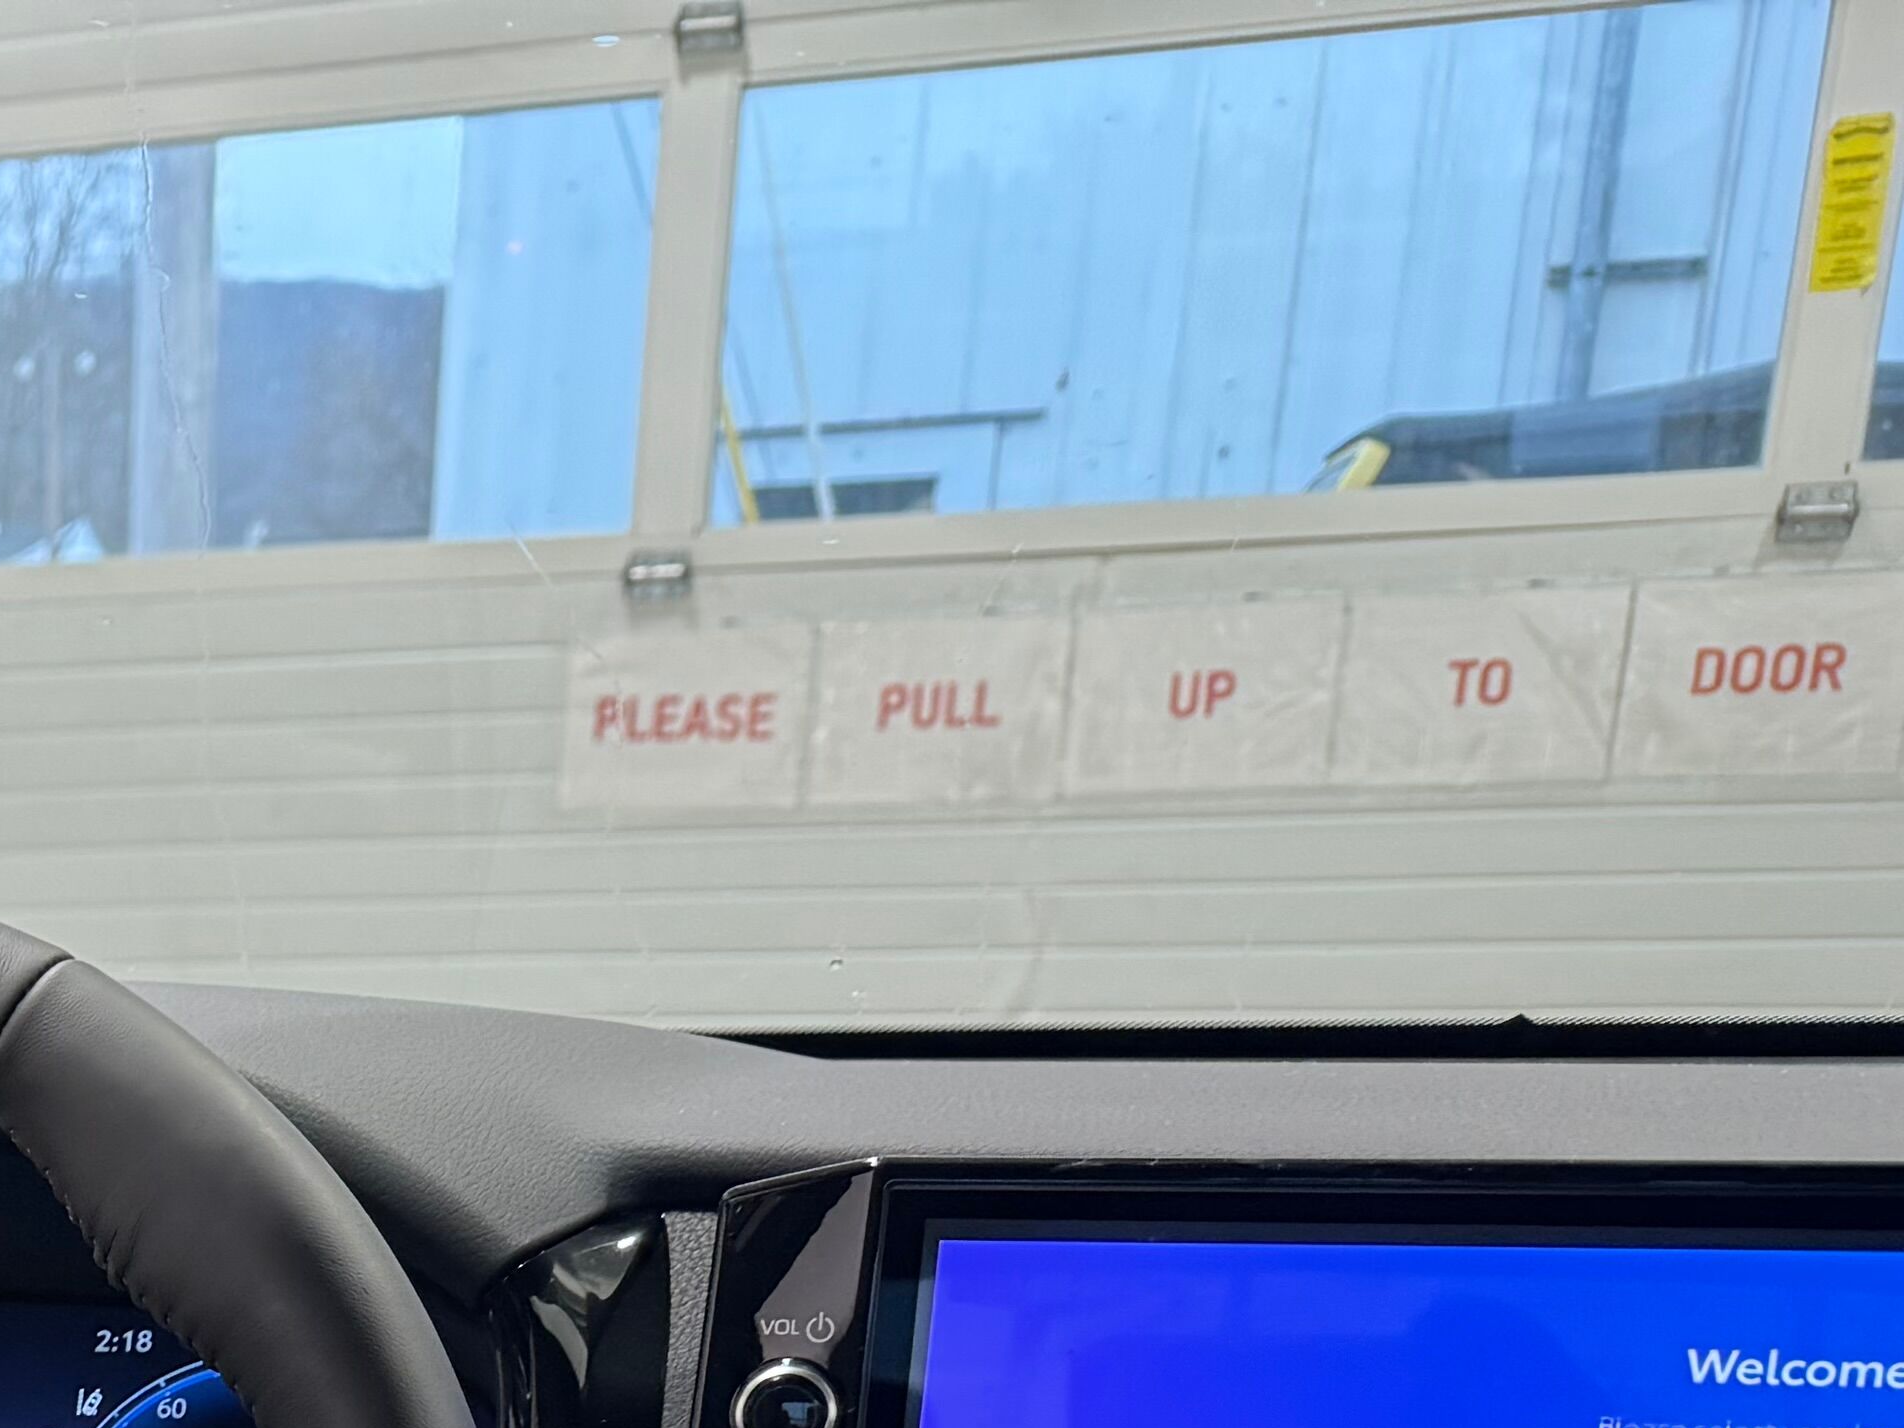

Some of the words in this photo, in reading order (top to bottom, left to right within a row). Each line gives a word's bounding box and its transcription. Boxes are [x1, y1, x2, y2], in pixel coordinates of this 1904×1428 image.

[592, 691, 778, 742] PLEASE
[876, 680, 1002, 731] PULL
[1168, 670, 1237, 718] UP
[1448, 658, 1513, 707] TO
[1690, 642, 1848, 696] DOOR
[760, 1318, 800, 1336] VOL
[94, 1330, 153, 1353] 2:18
[1687, 1348, 1904, 1389] Welcome
[156, 1398, 187, 1420] 60
